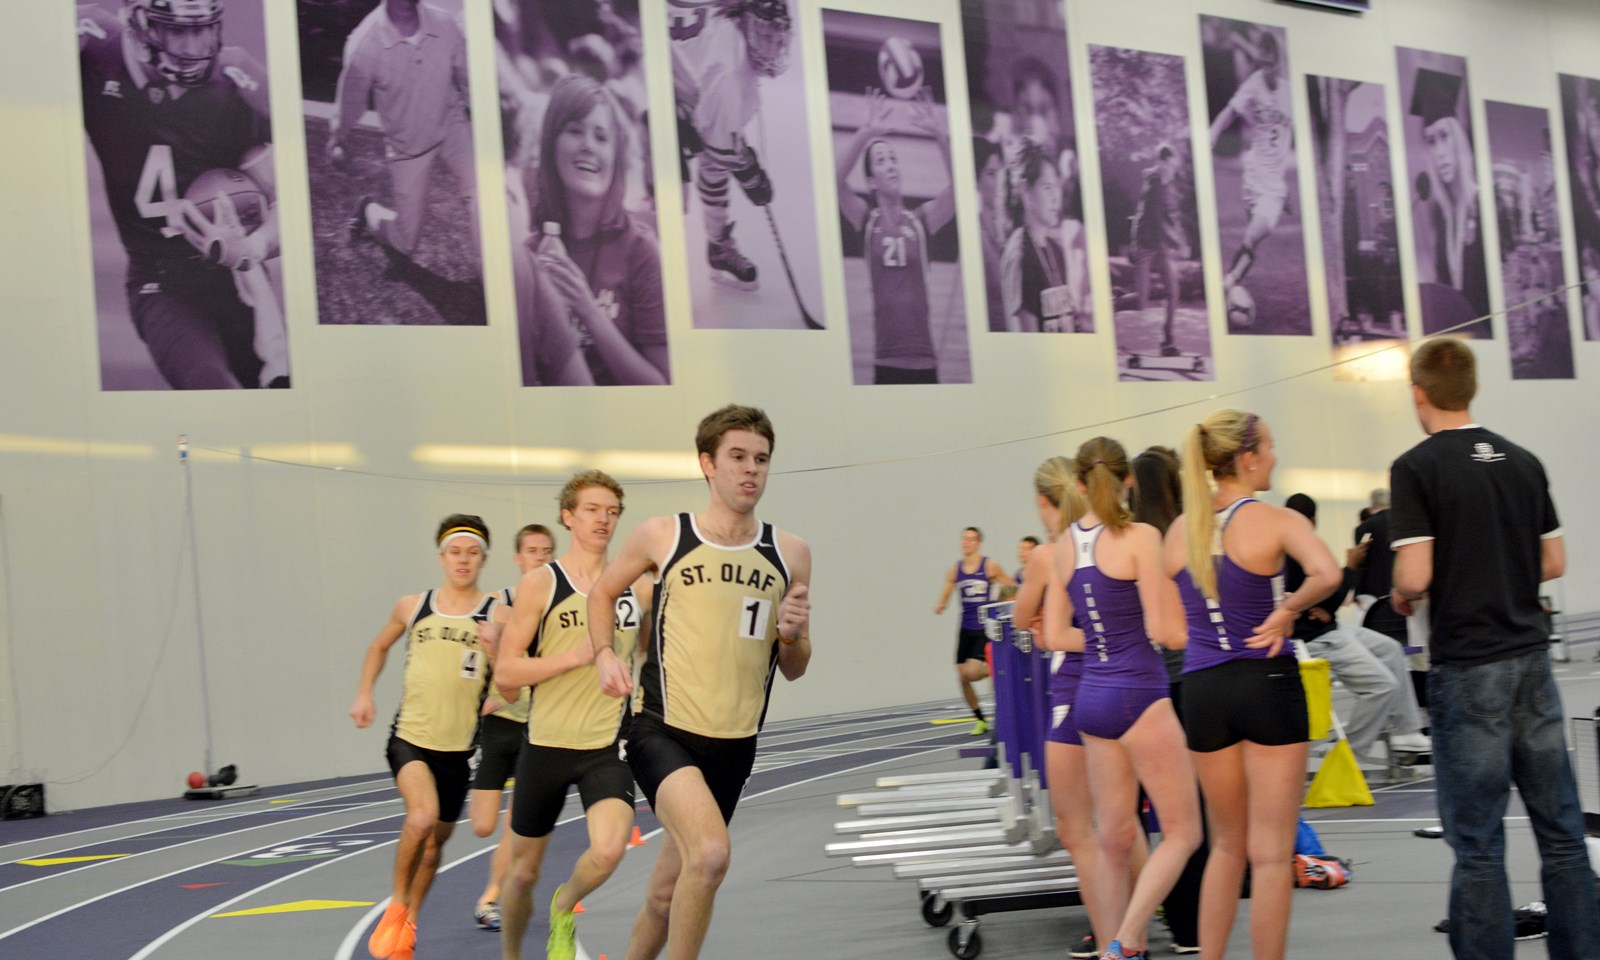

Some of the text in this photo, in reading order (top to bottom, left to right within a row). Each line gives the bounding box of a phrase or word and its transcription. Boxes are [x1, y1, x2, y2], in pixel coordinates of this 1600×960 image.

[134, 144, 185, 238] 4
[882, 236, 907, 267] 21
[681, 563, 776, 592] ST. OLAF
[559, 610, 584, 629] ST.
[618, 599, 636, 628] 2
[745, 601, 760, 636] 1
[463, 652, 478, 678] 4
